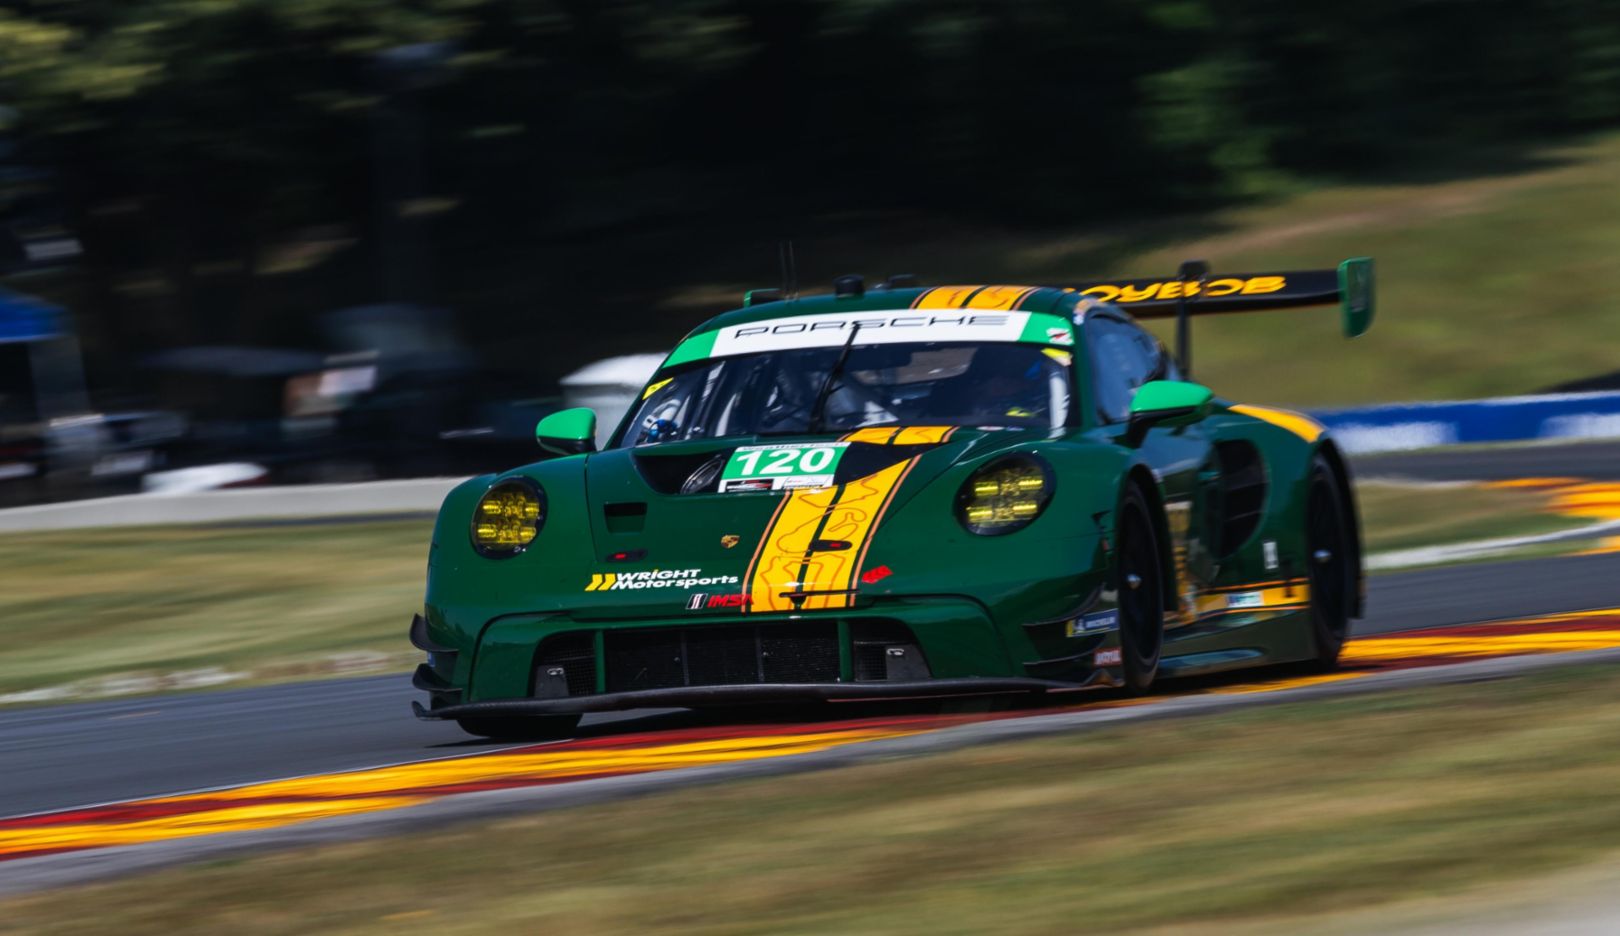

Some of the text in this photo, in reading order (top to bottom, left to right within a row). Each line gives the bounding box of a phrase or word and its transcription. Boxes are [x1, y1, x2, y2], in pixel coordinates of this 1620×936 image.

[734, 315, 1009, 338] PORSCHE
[736, 448, 835, 476] 120
[611, 575, 739, 590] Motorsports
